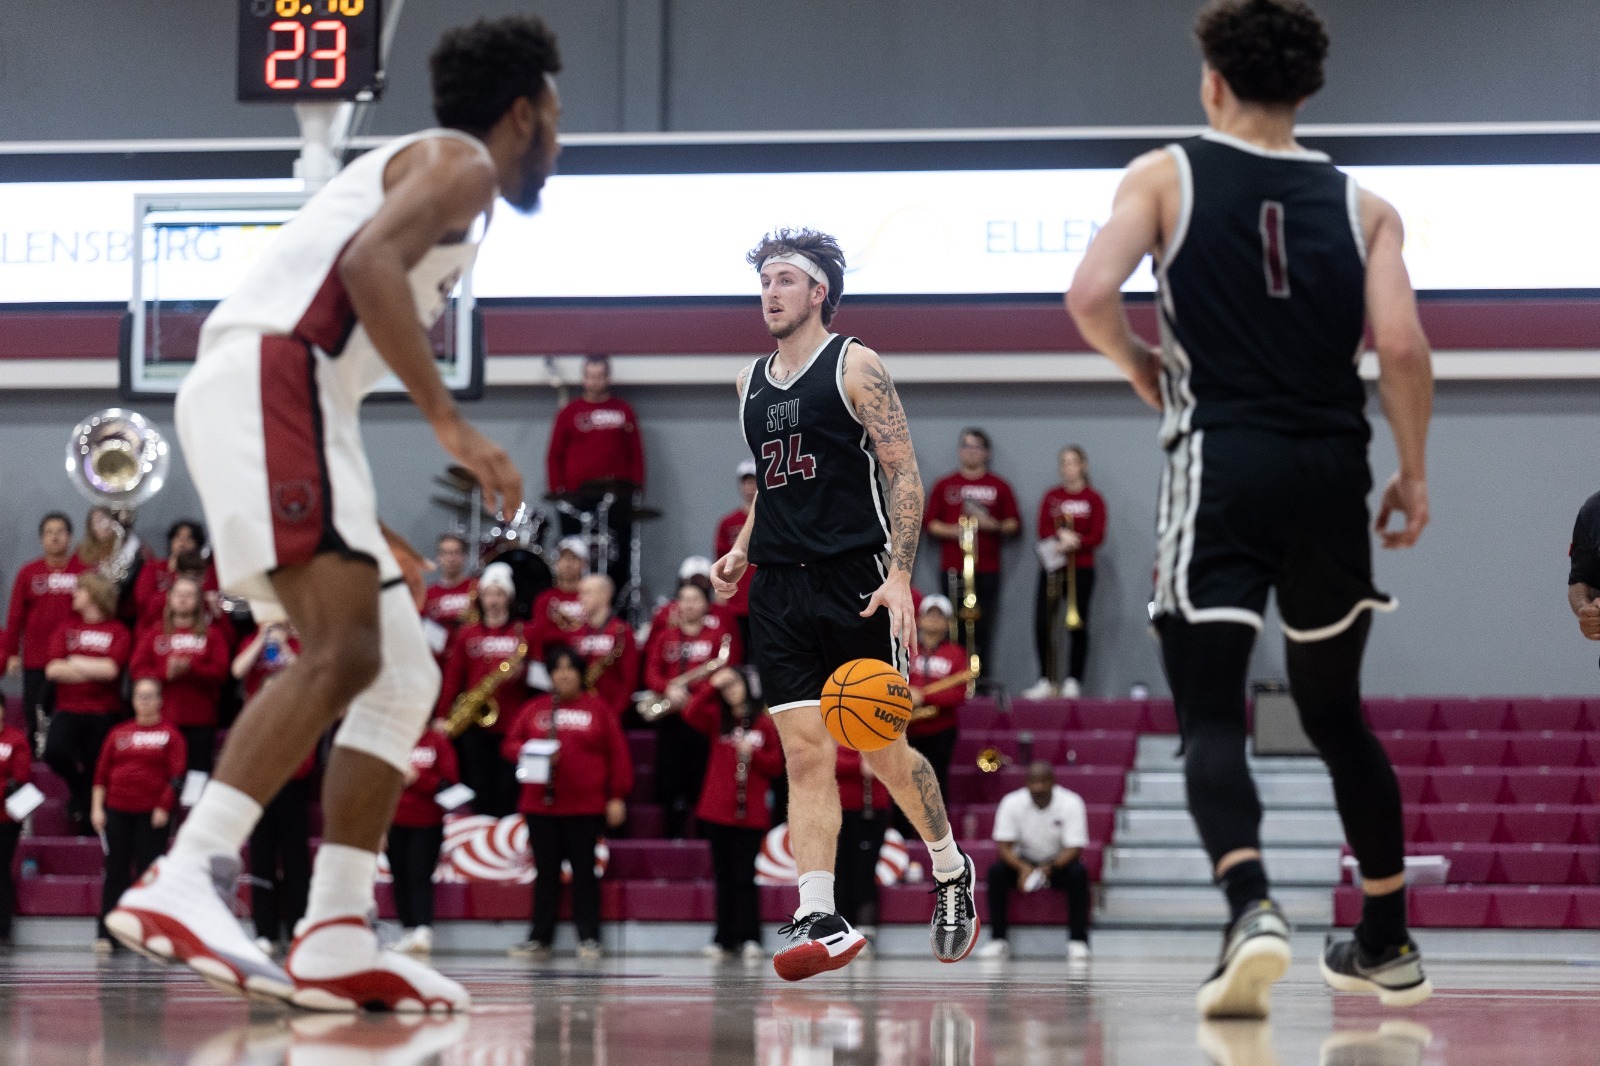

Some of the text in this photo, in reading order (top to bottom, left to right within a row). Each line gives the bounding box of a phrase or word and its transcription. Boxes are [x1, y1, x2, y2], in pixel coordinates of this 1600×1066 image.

[264, 20, 347, 89] 23
[1259, 200, 1292, 299] 1
[766, 398, 800, 433] SPU
[761, 433, 816, 490] 24
[874, 705, 908, 733] ilson
